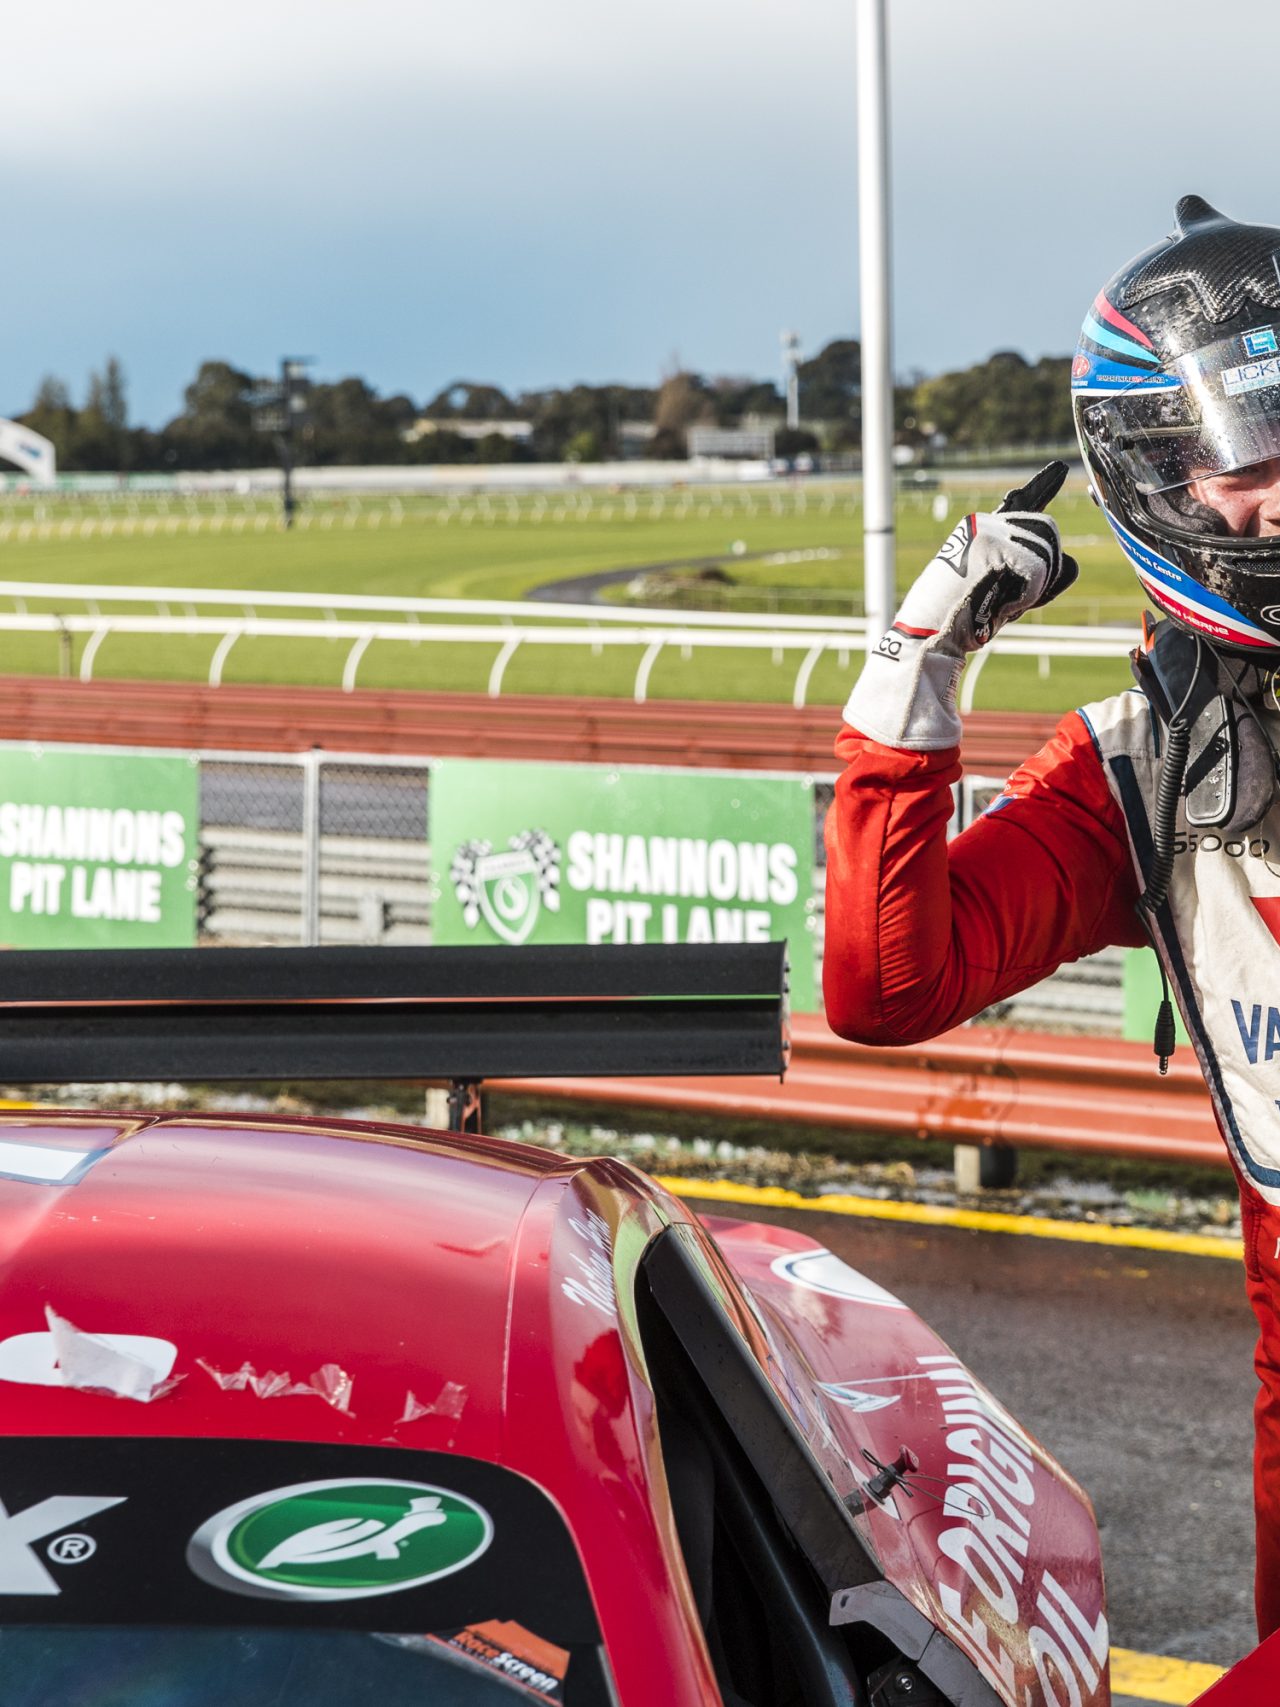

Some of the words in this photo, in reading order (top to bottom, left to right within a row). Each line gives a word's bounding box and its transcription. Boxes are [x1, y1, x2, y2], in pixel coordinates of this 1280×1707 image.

[0, 802, 185, 868] SHANNONS
[566, 830, 798, 905] SHANNONS
[9, 861, 66, 916] PIT
[71, 865, 162, 923] LANE
[586, 898, 652, 945] PIT
[1028, 1569, 1109, 1707] OIL
